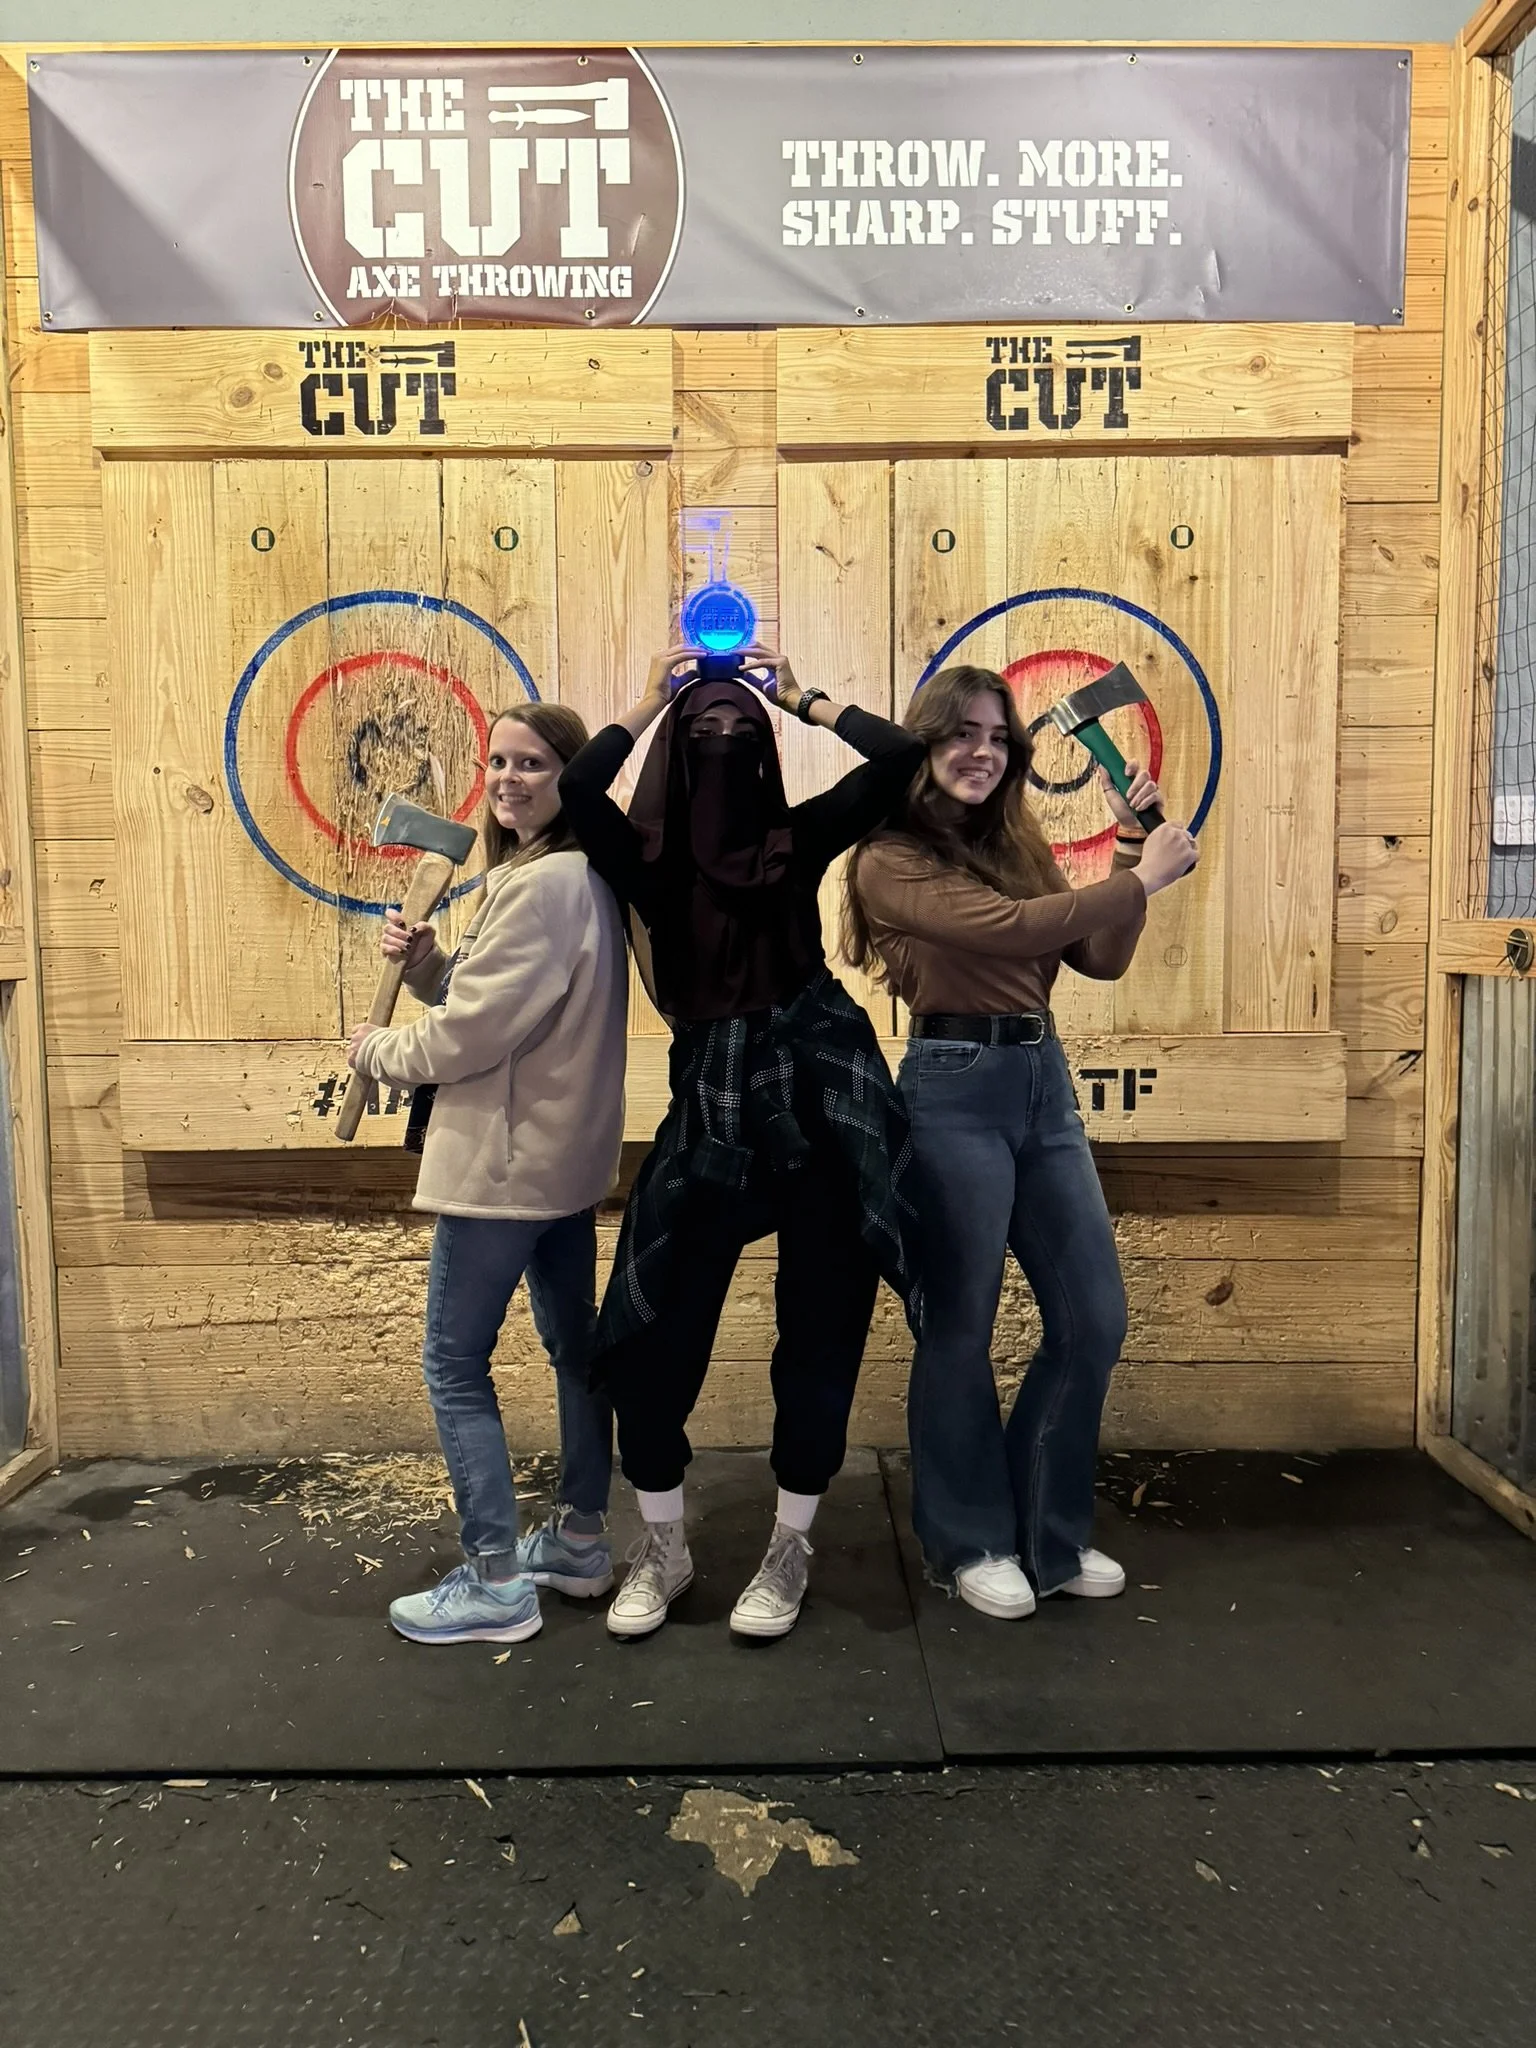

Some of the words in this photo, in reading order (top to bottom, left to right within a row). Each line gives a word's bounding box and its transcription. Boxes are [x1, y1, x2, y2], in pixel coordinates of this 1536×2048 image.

[340, 78, 464, 131] THE
[782, 140, 999, 188] THROW.
[1018, 140, 1183, 188] MORE.
[342, 138, 631, 258] CUT
[782, 199, 973, 246] SHARP.
[992, 199, 1182, 246] STUFF.
[347, 265, 420, 299] AXE
[432, 264, 632, 299] THROWING
[298, 341, 366, 368] THE
[986, 336, 1052, 364] THE
[299, 373, 456, 436] CUT
[986, 368, 1142, 431] CUT
